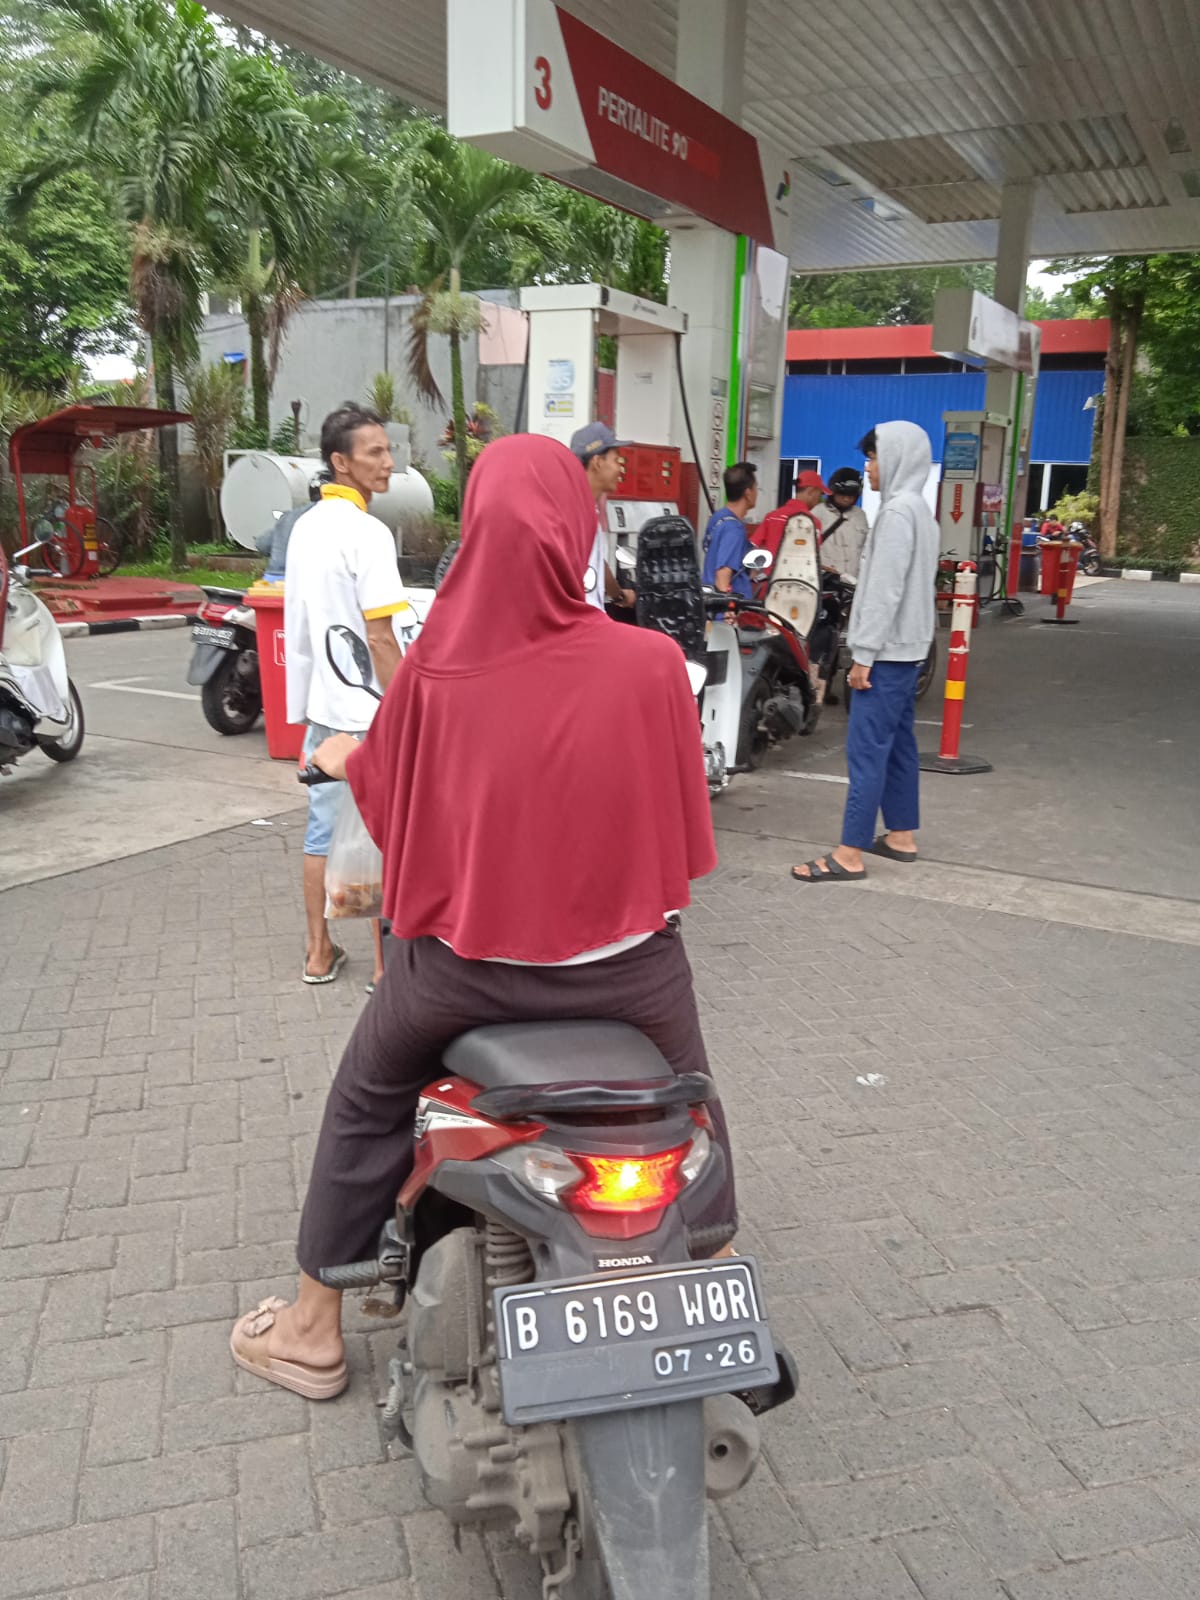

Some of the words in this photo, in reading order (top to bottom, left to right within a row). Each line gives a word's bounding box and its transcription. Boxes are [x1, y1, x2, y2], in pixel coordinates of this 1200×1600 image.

[534, 55, 552, 110] 3
[598, 86, 669, 151] PERTALITE
[672, 132, 688, 160] 90
[598, 1255, 653, 1268] HONDA
[515, 1306, 539, 1350] B
[564, 1291, 658, 1344] 6169
